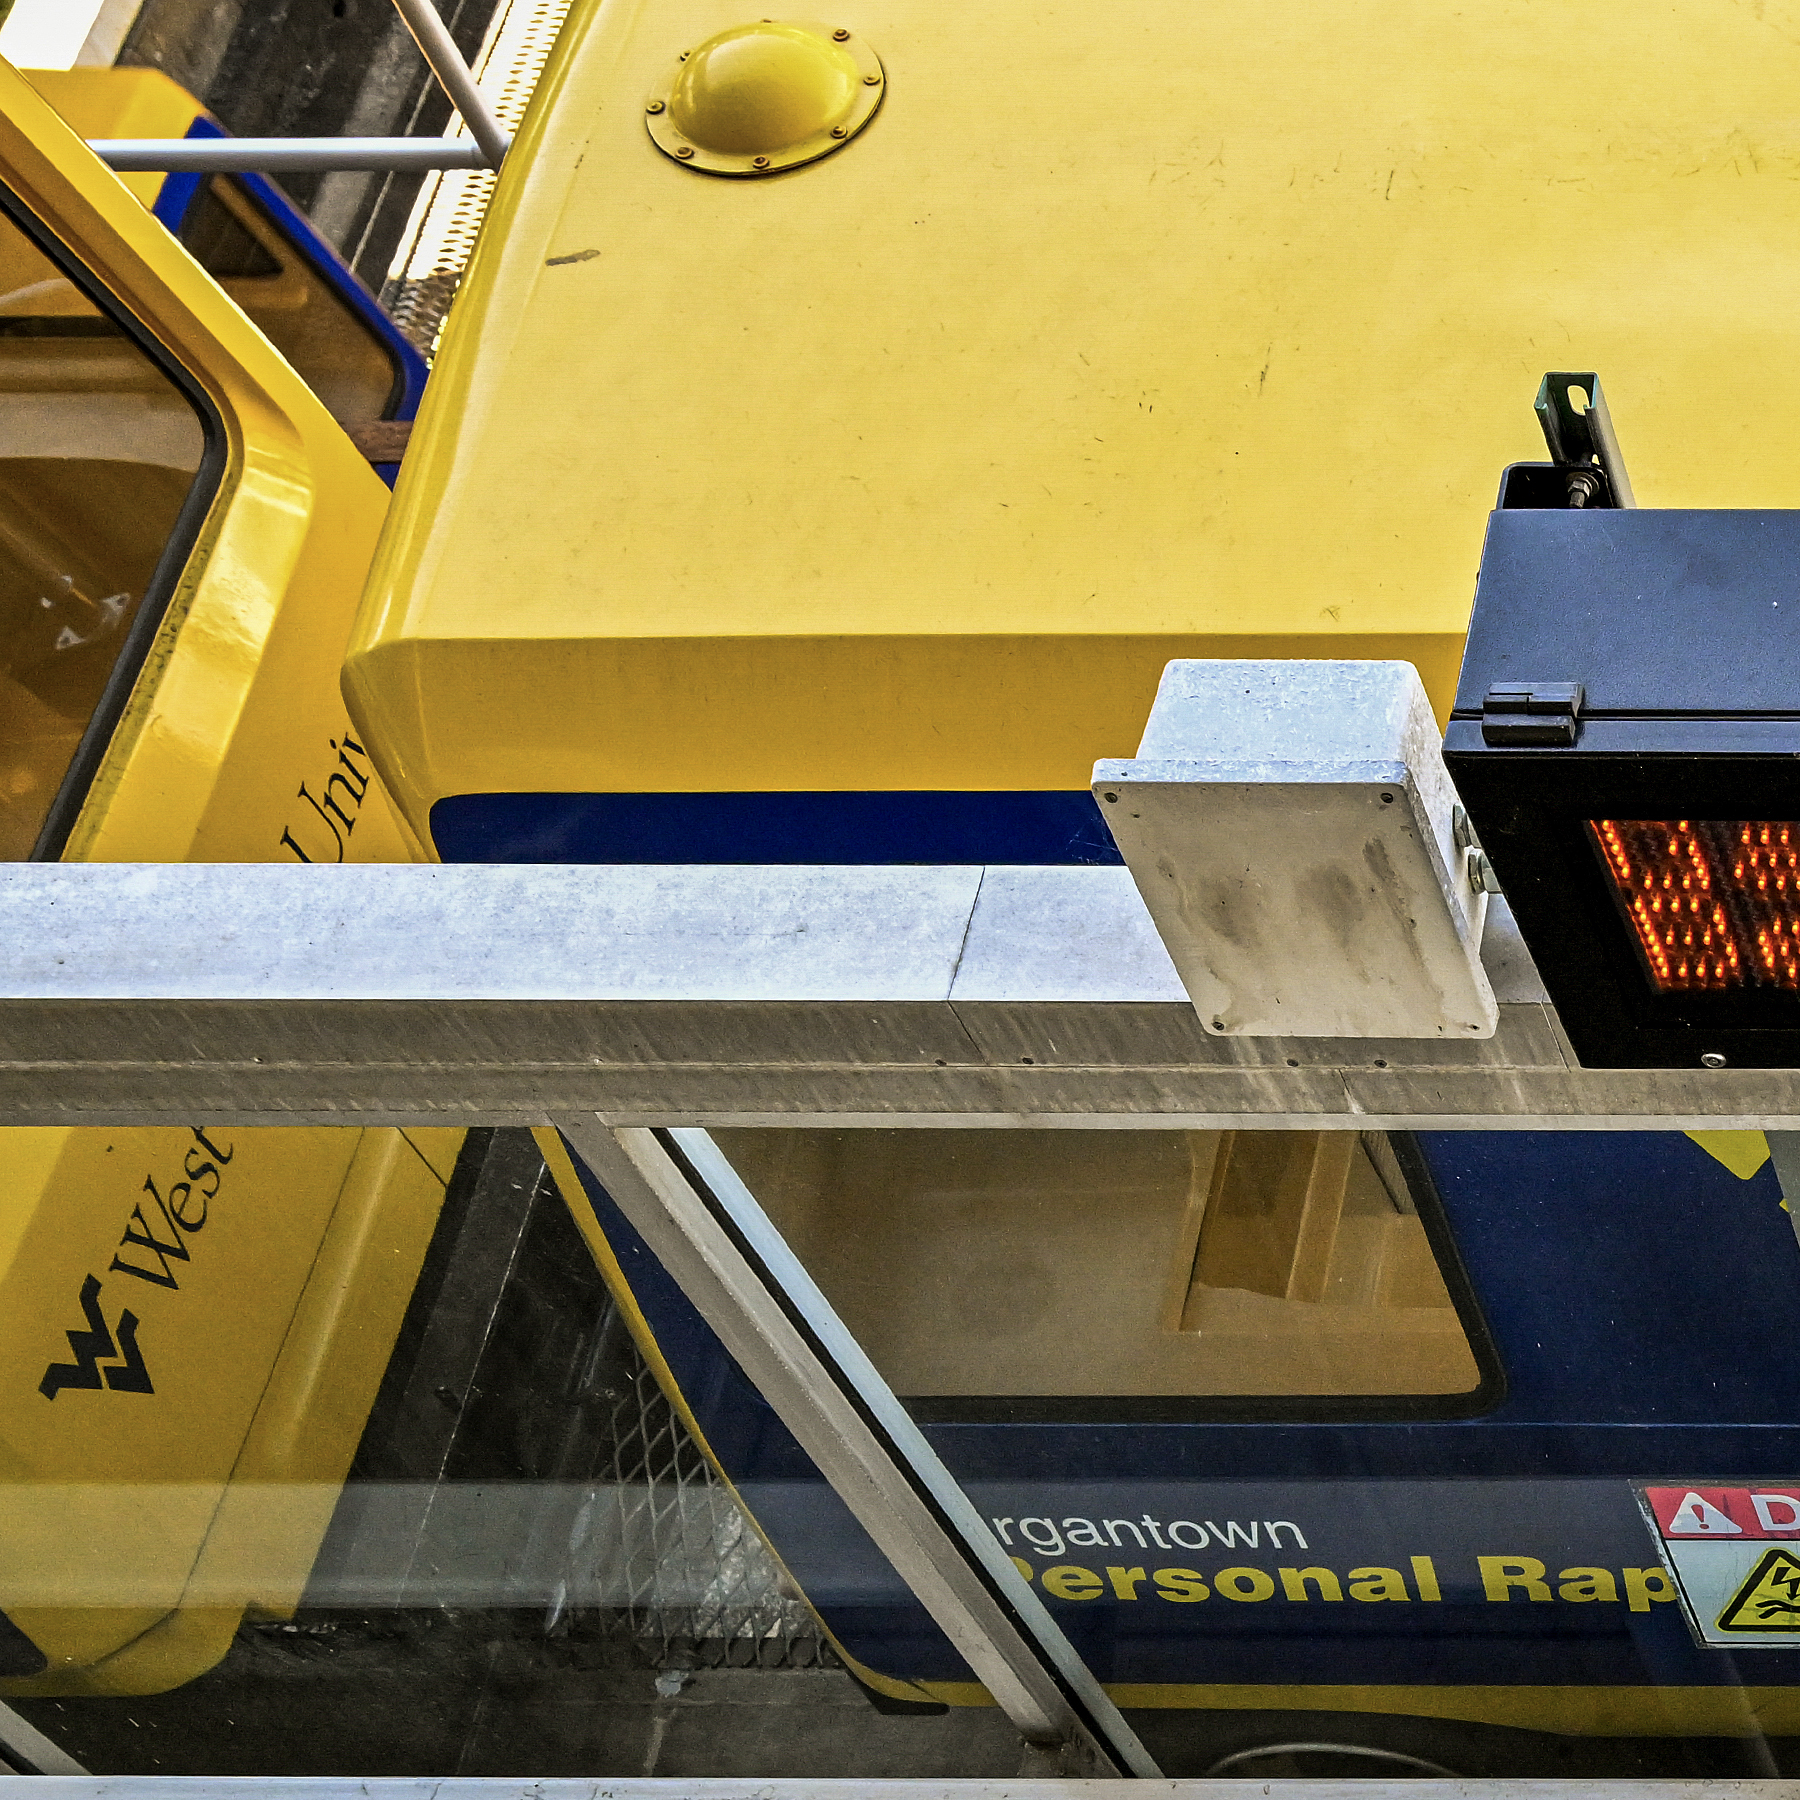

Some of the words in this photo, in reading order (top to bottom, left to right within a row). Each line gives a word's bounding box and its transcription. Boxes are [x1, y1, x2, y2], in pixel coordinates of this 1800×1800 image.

[108, 1126, 233, 1290] West
[991, 1514, 1309, 1556] rgantown
[1477, 1555, 1680, 1612] Rap
